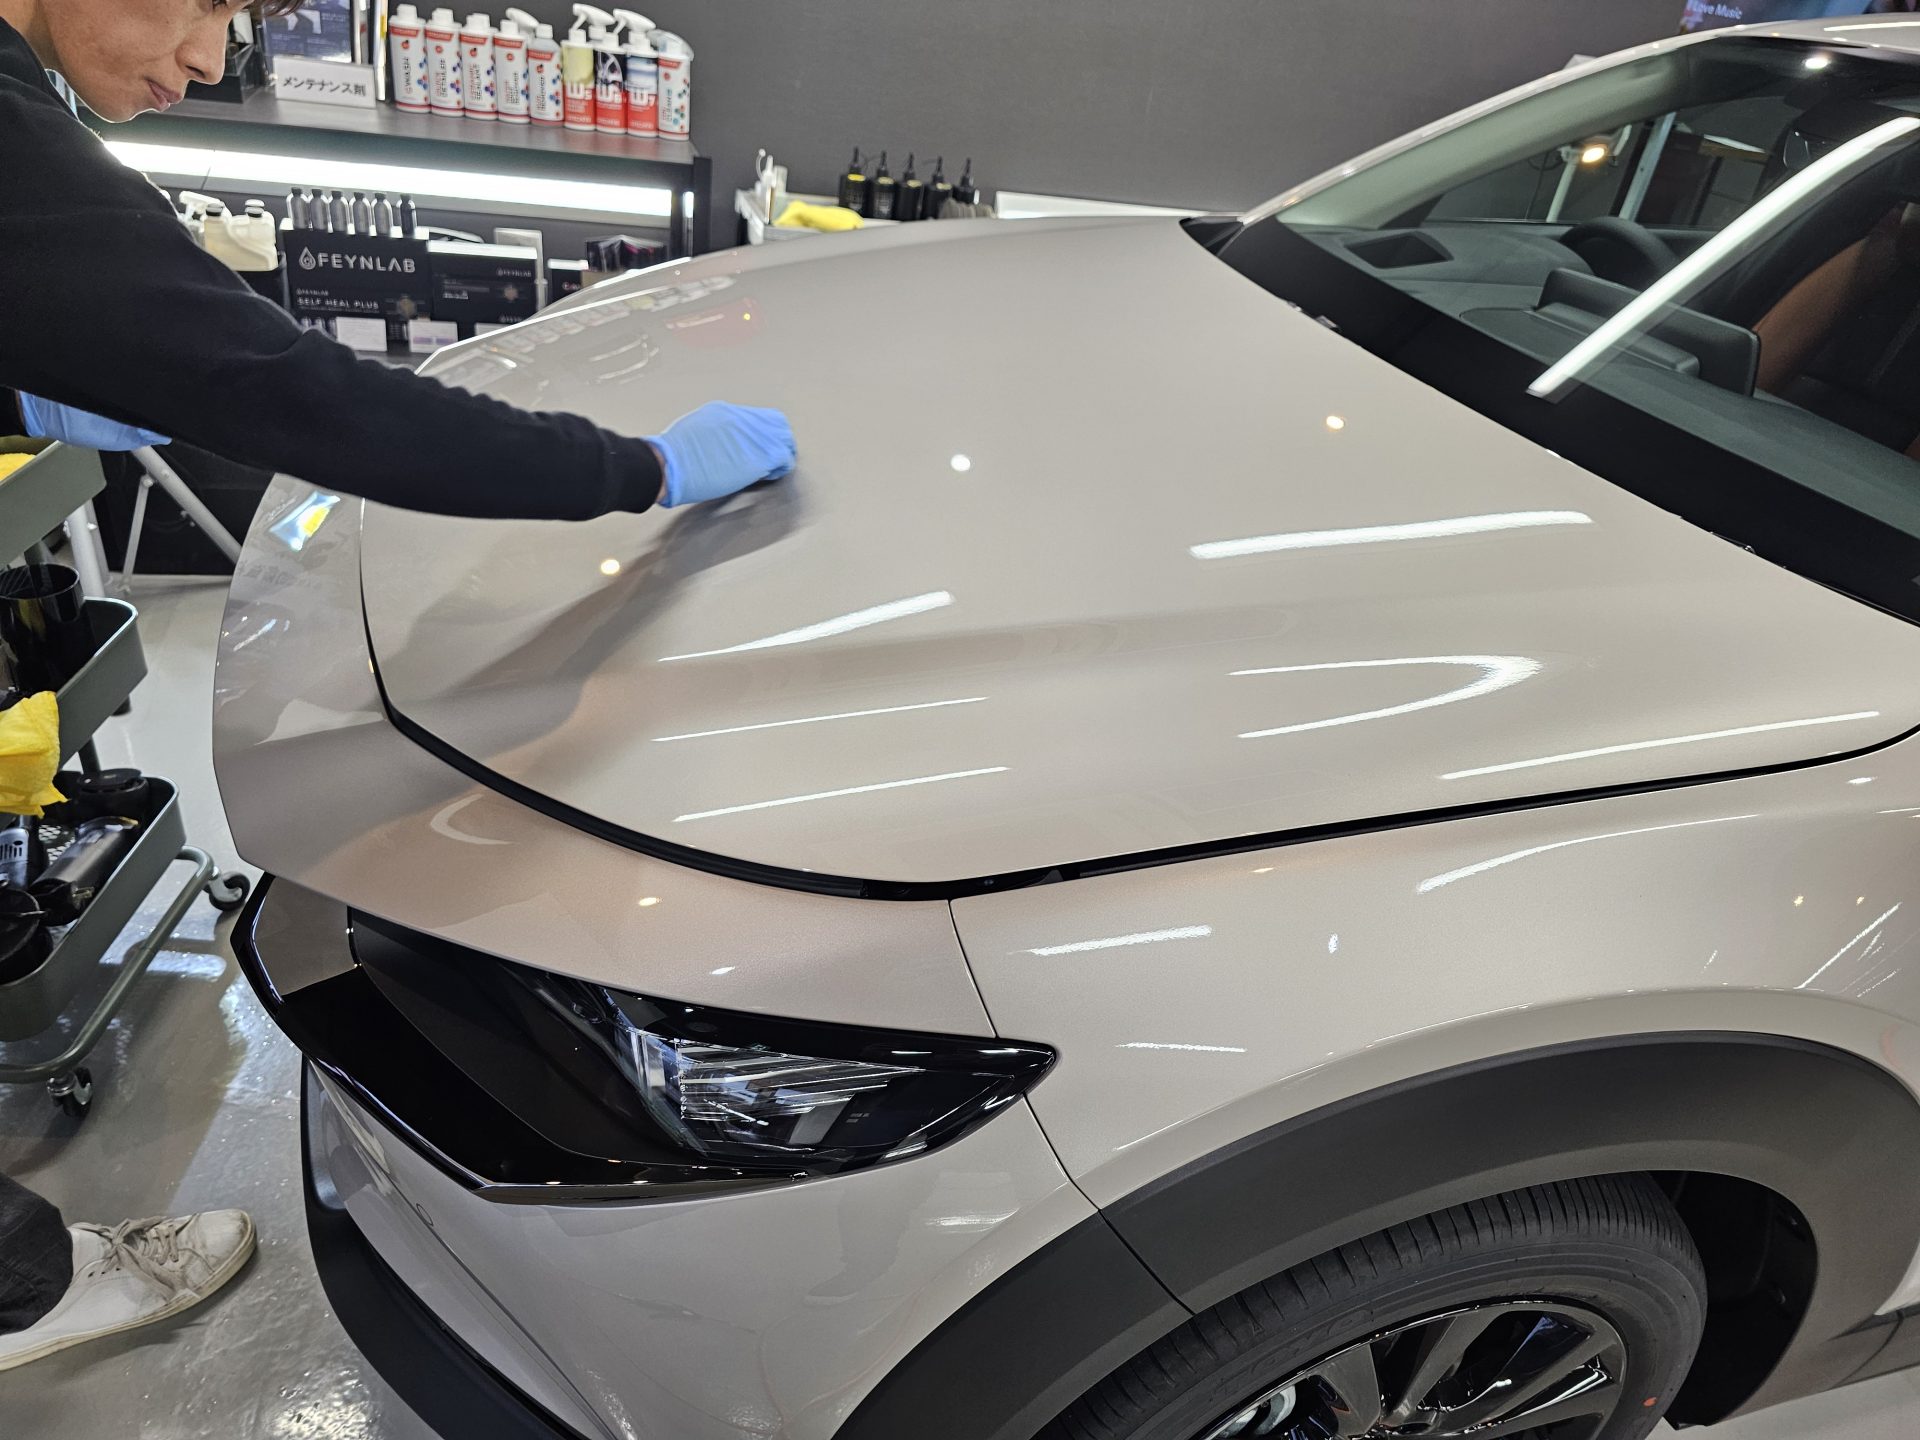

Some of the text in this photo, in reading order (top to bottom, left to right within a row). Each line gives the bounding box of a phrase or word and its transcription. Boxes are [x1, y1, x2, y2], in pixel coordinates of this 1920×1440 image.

[1715, 3, 1743, 20] Music
[283, 76, 367, 97] メンテナンス剤
[317, 252, 416, 273] FEYNLAB
[325, 299, 349, 308] HEAL
[354, 300, 379, 309] PLUS
